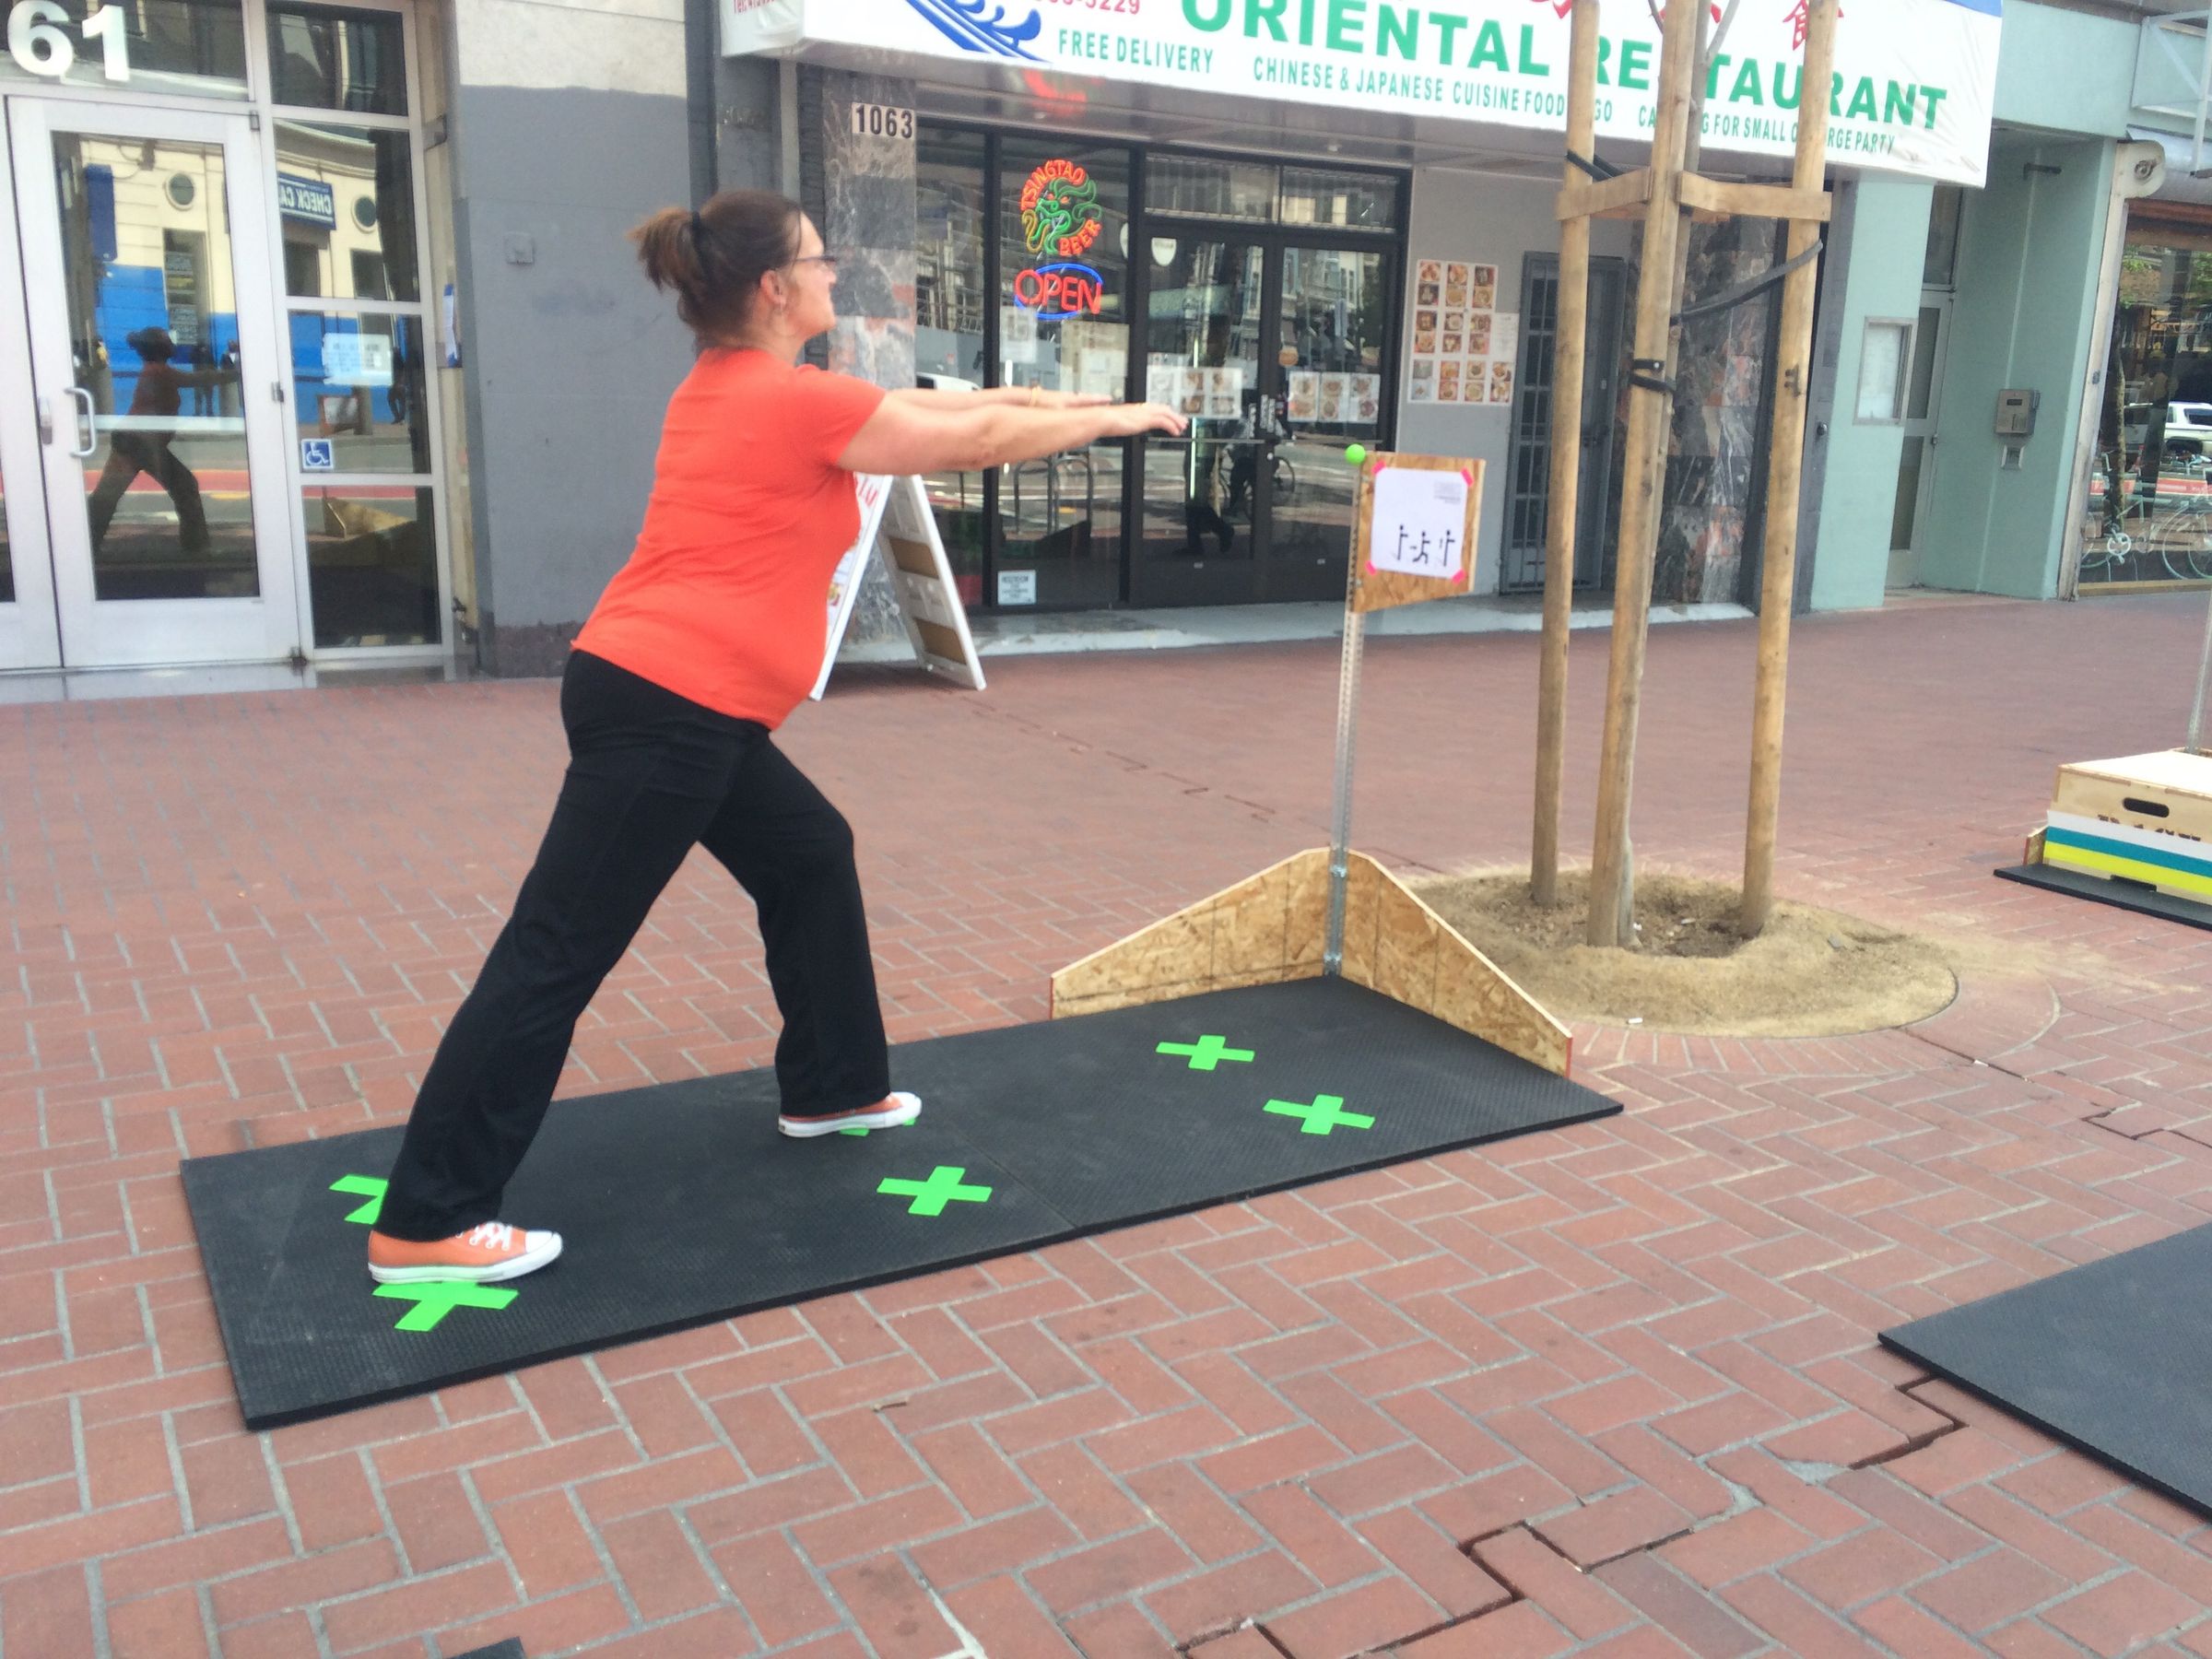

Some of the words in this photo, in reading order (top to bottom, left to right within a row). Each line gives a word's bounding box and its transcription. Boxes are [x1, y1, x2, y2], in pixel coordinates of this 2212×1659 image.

[7, 0, 130, 82] 61
[1059, 29, 1110, 61] FREE
[1117, 36, 1214, 74] DELIVERY
[1181, 0, 1549, 76] ORIENTAL
[1597, 35, 1947, 130] ETAUANT
[1253, 56, 1333, 89] CHINESE
[1340, 66, 1349, 91] &
[1356, 70, 1443, 102] JAPANESE
[1453, 81, 1519, 112] CUISINE
[1524, 89, 1565, 117] FOOD
[855, 104, 912, 139] 1063
[1714, 114, 1740, 137] FOR
[1743, 117, 1786, 142] SMALL
[1828, 127, 1852, 150] RGE
[1854, 131, 1895, 155] PARTY
[1020, 159, 1086, 211] TSINGTAO
[1058, 218, 1101, 256] BEER
[1015, 268, 1101, 314] OPEN
